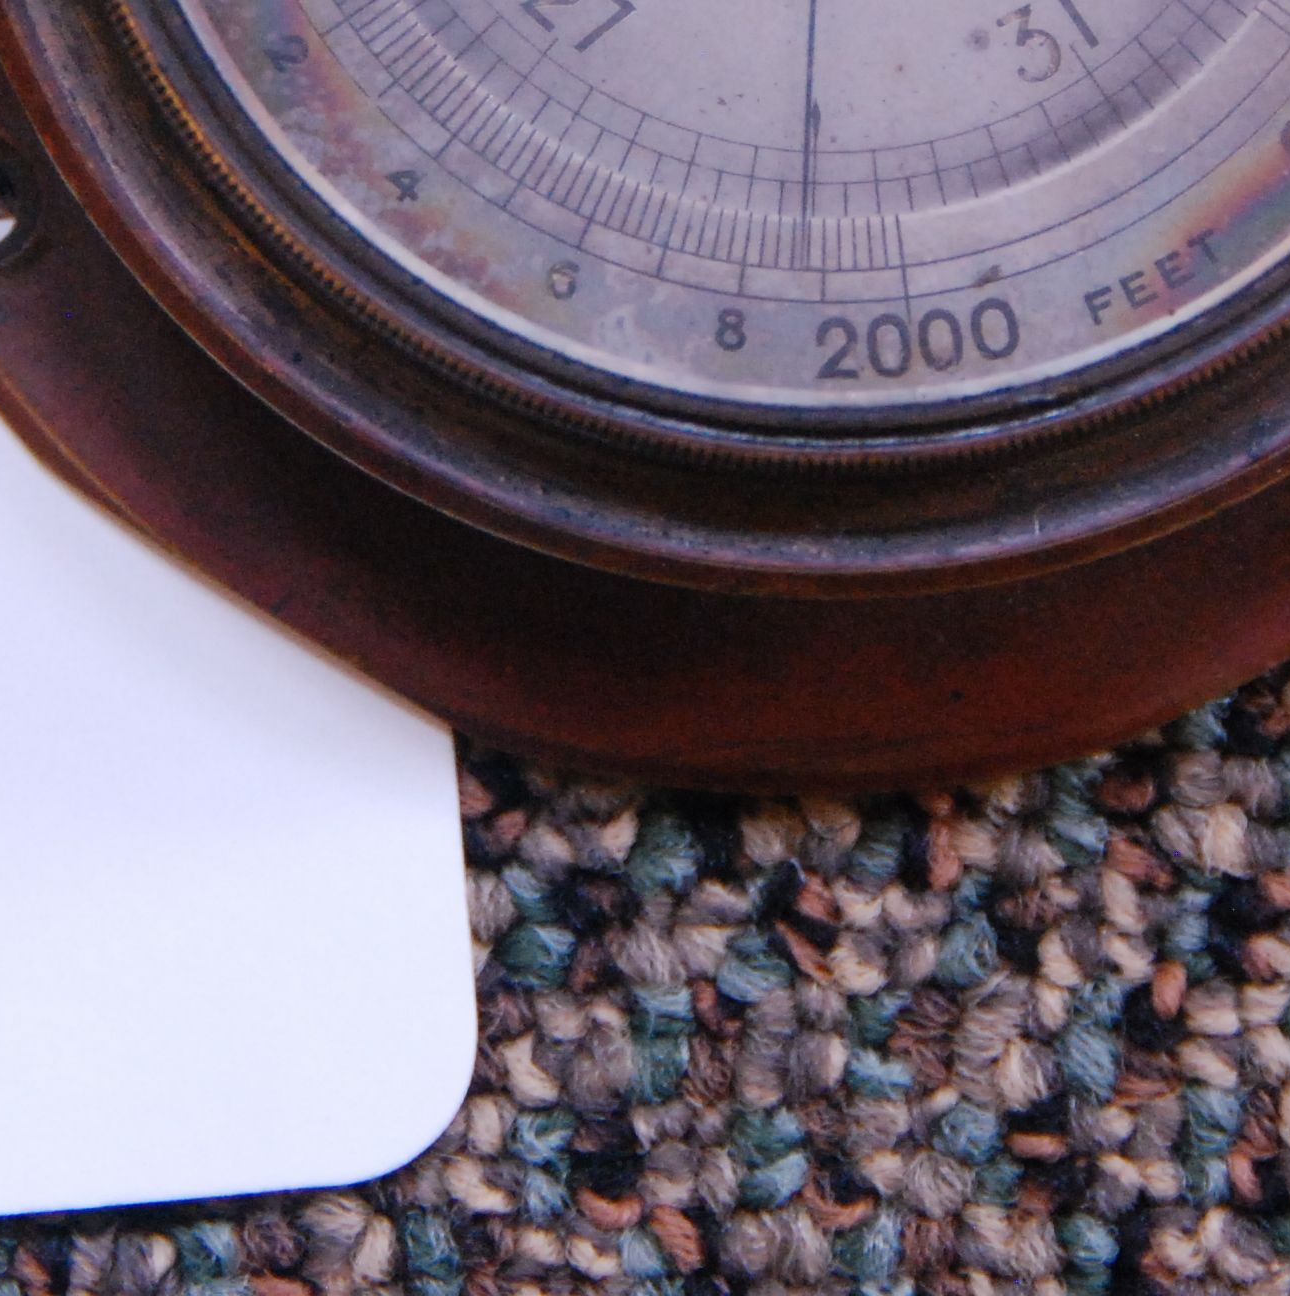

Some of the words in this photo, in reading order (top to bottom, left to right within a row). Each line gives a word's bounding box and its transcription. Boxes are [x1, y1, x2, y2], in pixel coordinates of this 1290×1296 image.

[386, 169, 426, 203] 4
[814, 297, 1021, 380] 2000
[1083, 229, 1221, 326] FEET
[714, 308, 747, 352] 8
